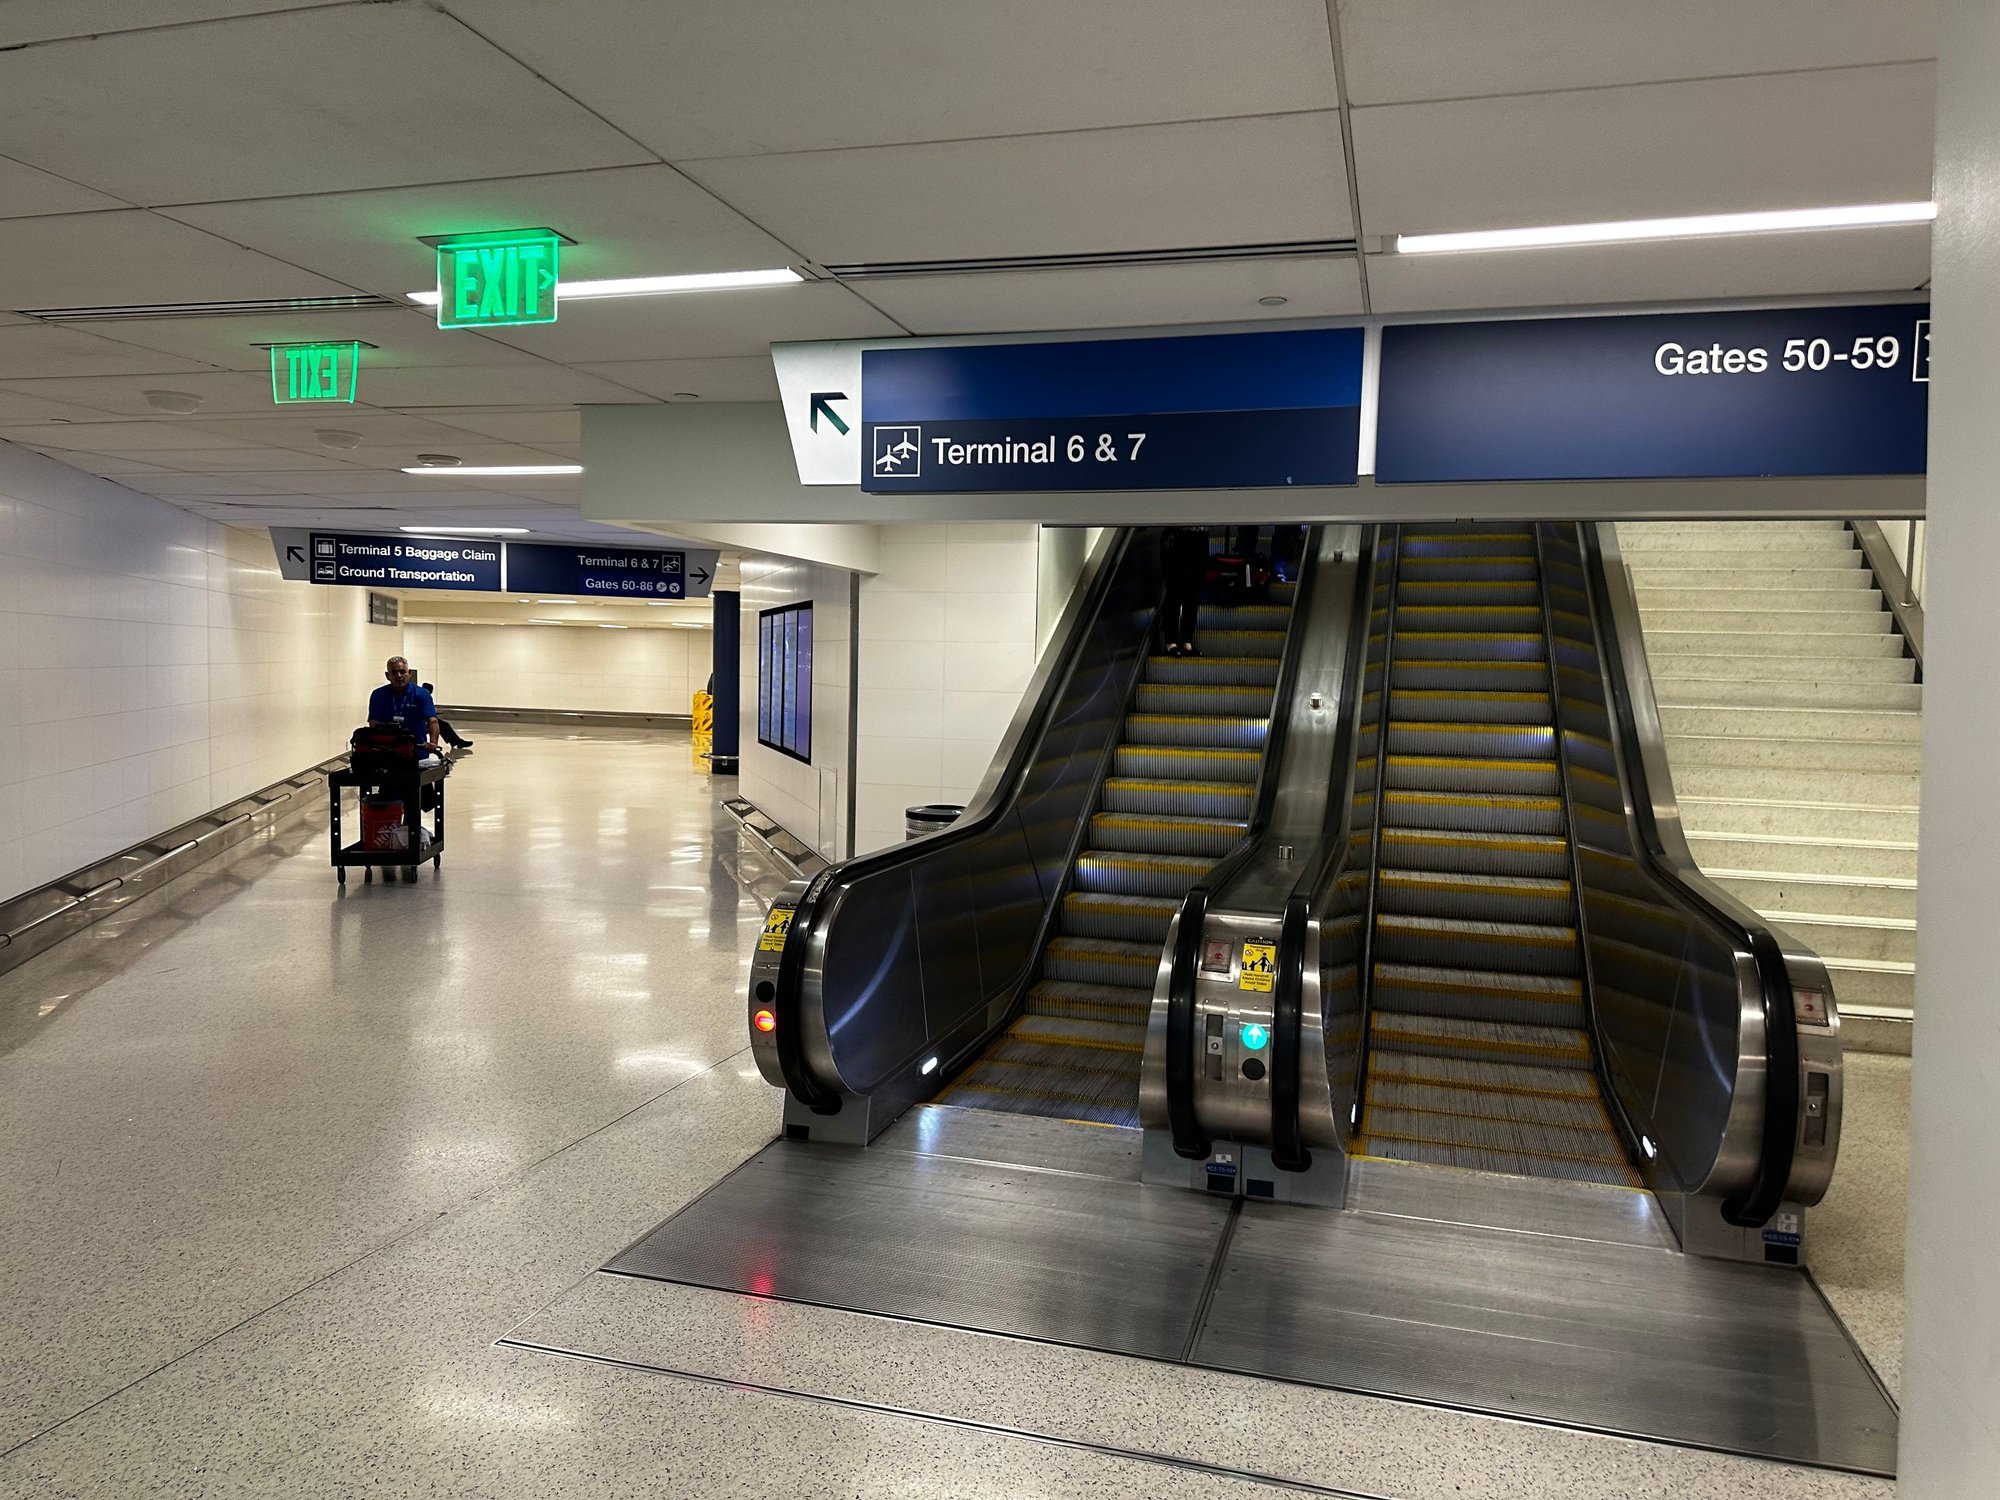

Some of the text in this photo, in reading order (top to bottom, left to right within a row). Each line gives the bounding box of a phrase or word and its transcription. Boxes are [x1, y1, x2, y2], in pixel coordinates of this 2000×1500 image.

[455, 245, 545, 318] EXIT
[1654, 336, 1900, 375] Gates 50-59
[931, 433, 1146, 465] Terminal 6 & 7
[339, 543, 496, 561] Terminal 5 Baggage Claim
[577, 555, 660, 569] Terminal 6 & 7
[339, 565, 475, 582] Ground Transportation
[585, 578, 654, 591] Gates 60-86
